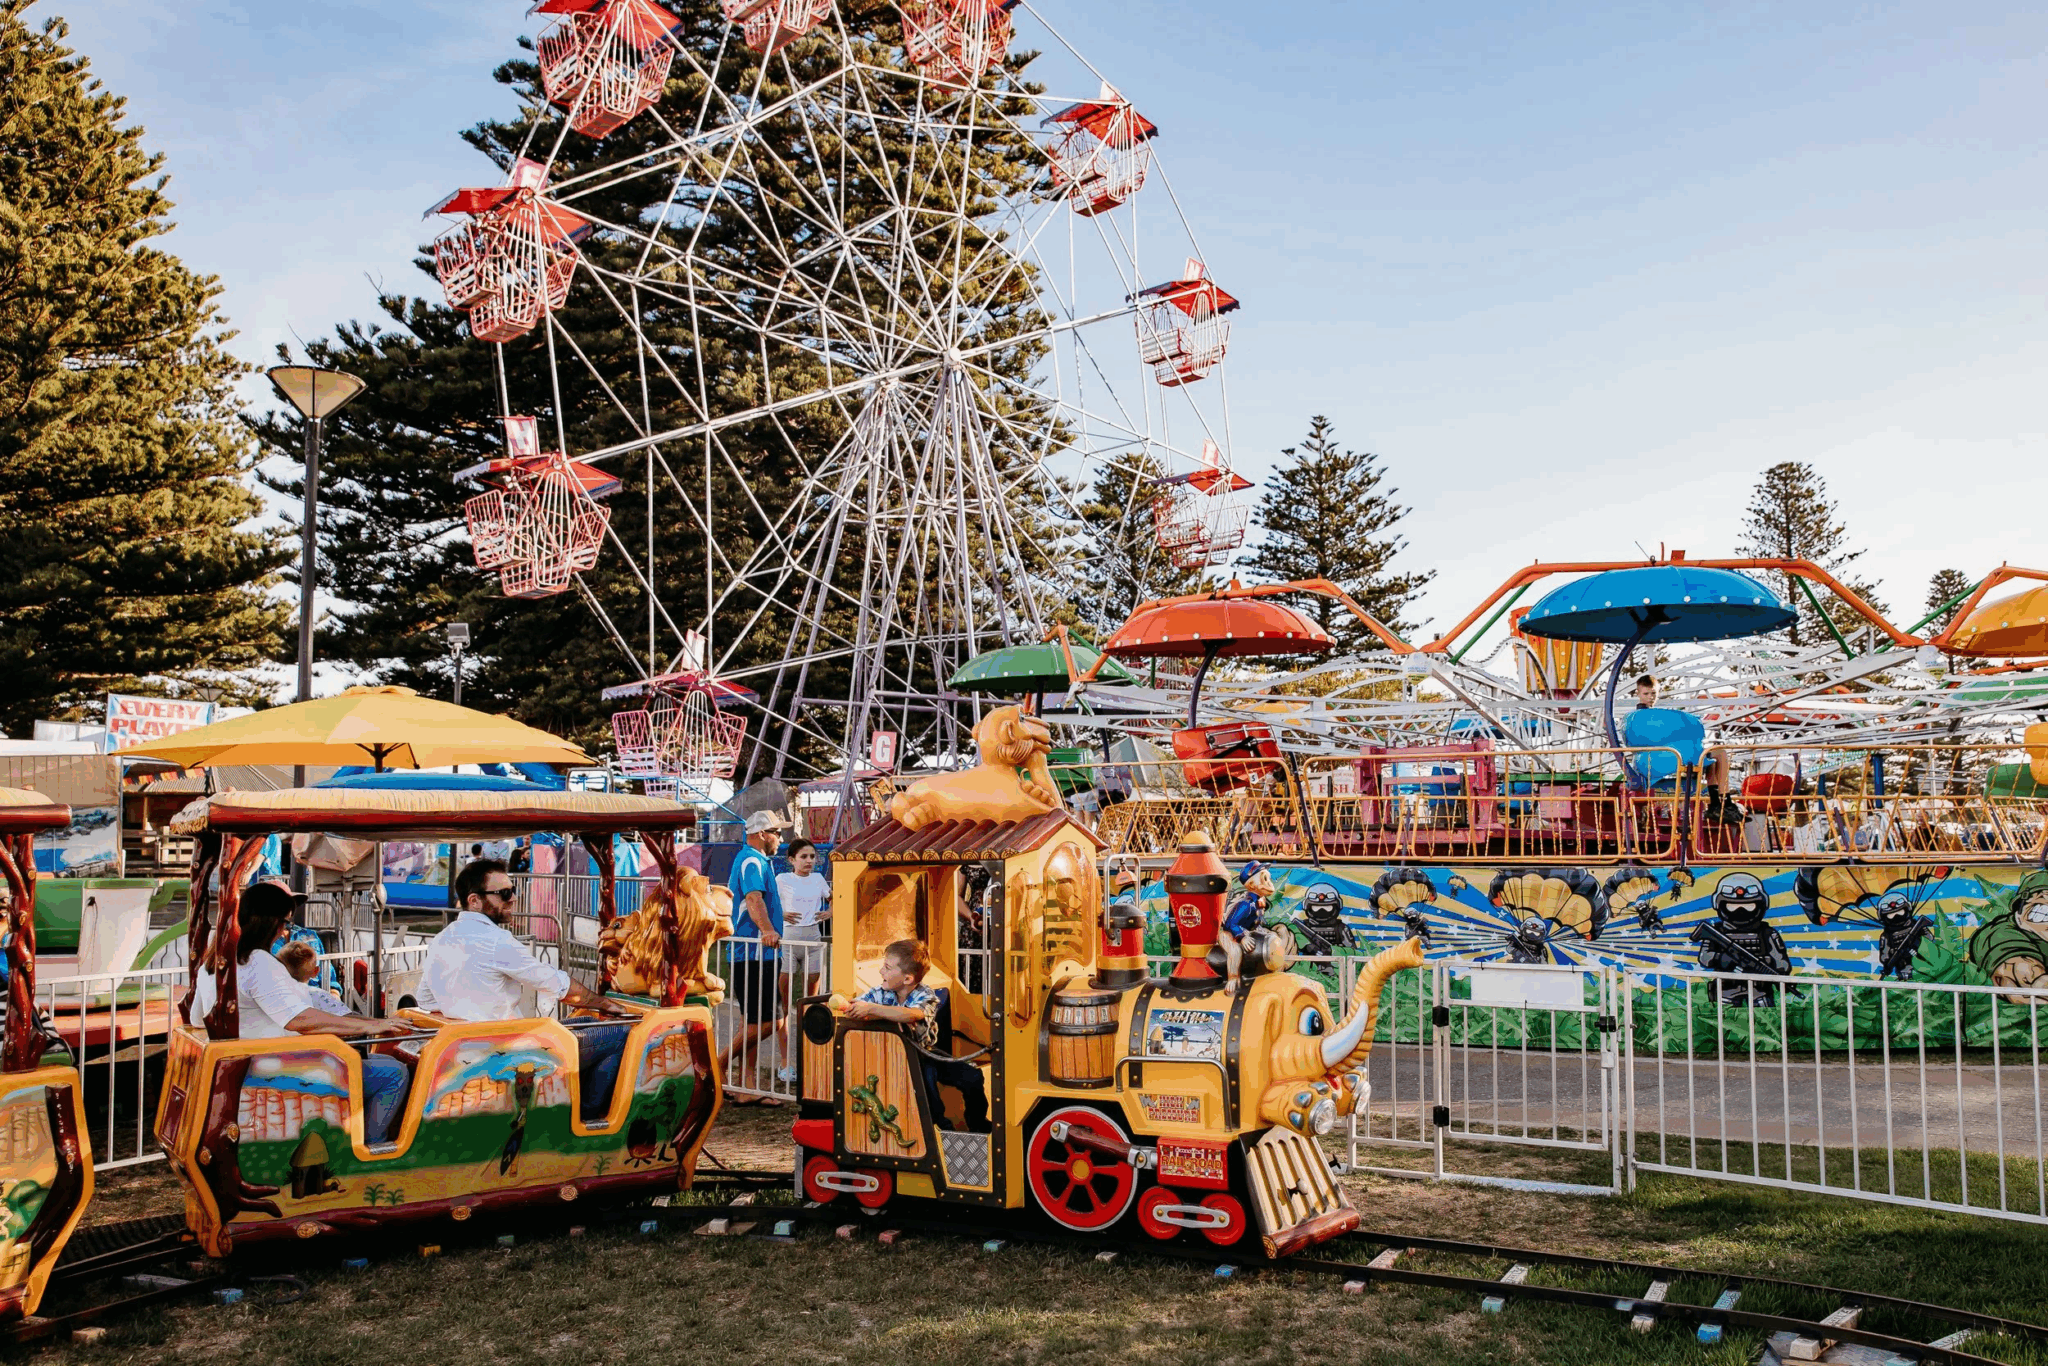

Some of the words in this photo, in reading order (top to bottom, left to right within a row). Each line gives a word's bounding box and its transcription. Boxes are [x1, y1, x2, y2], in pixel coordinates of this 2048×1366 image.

[119, 700, 200, 720] EVERY
[876, 735, 891, 763] G
[1318, 783, 1349, 793] FSH
